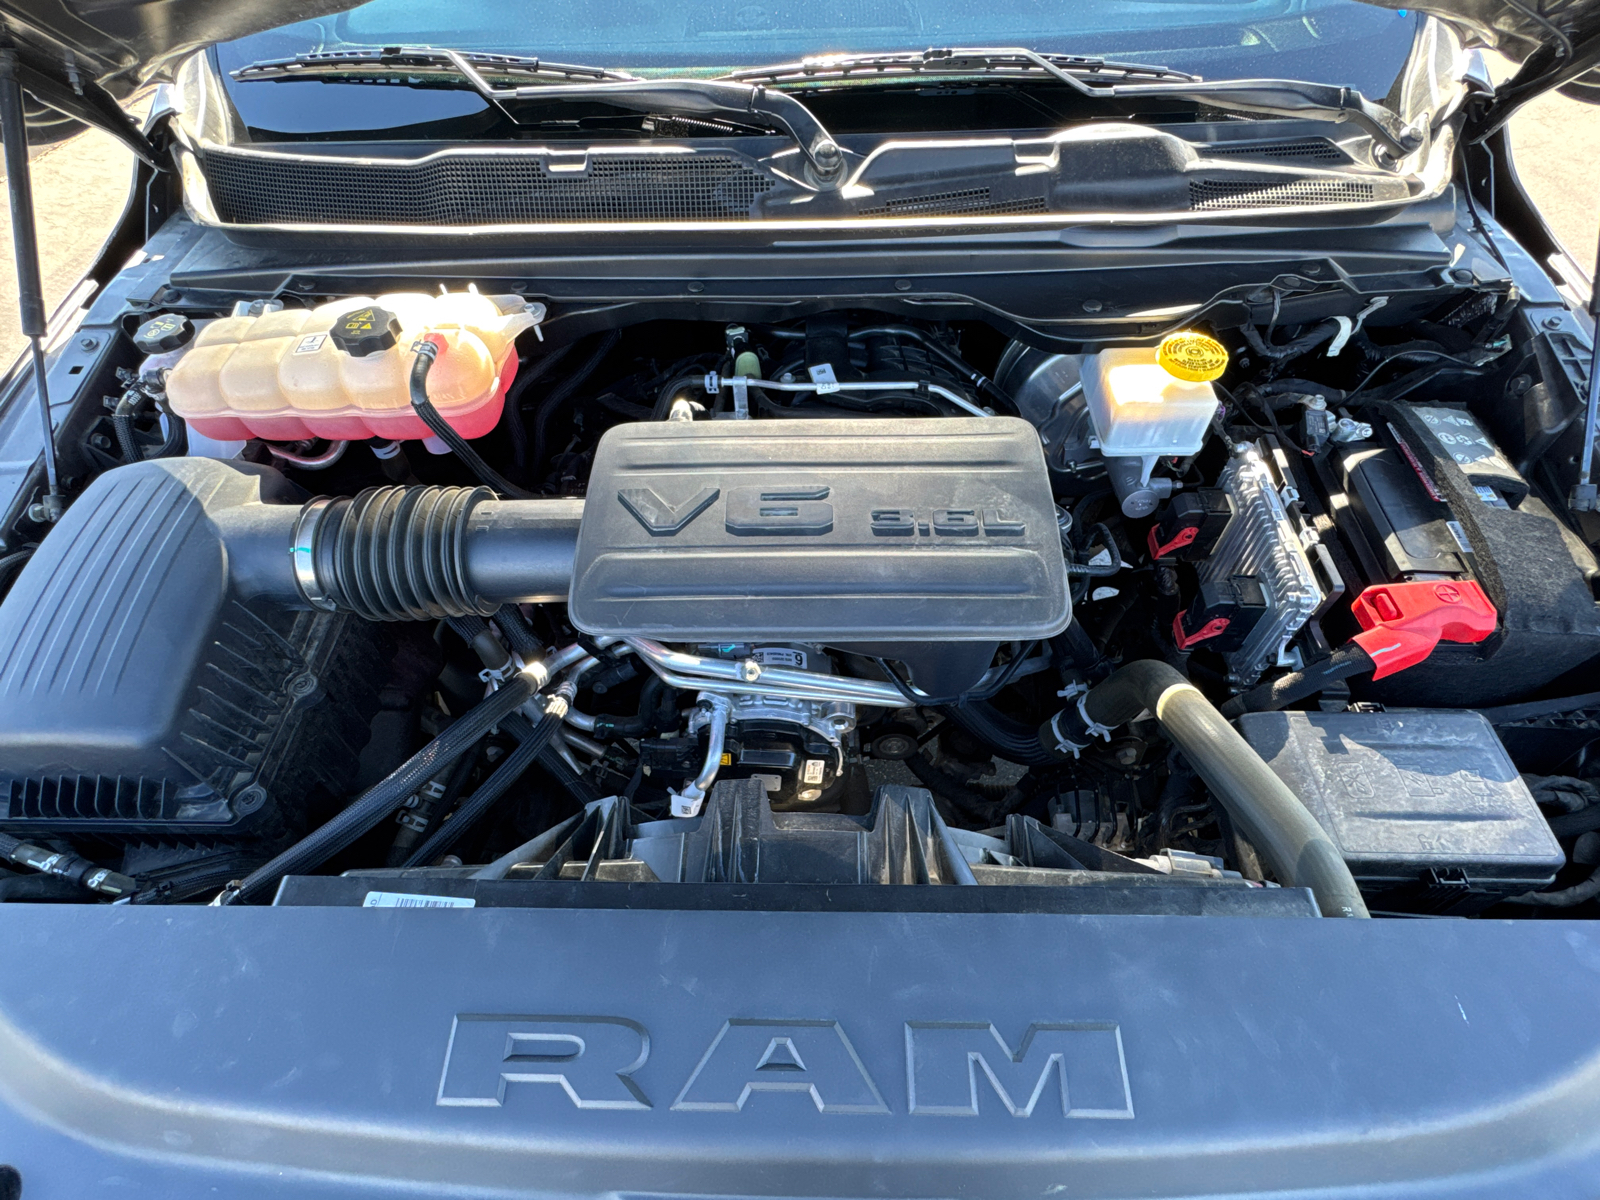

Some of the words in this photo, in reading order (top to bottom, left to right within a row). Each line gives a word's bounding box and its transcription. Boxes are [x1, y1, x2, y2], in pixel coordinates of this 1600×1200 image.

[617, 485, 835, 537] V6
[870, 508, 1027, 537] 3.6L
[436, 1013, 1136, 1119] RAM
